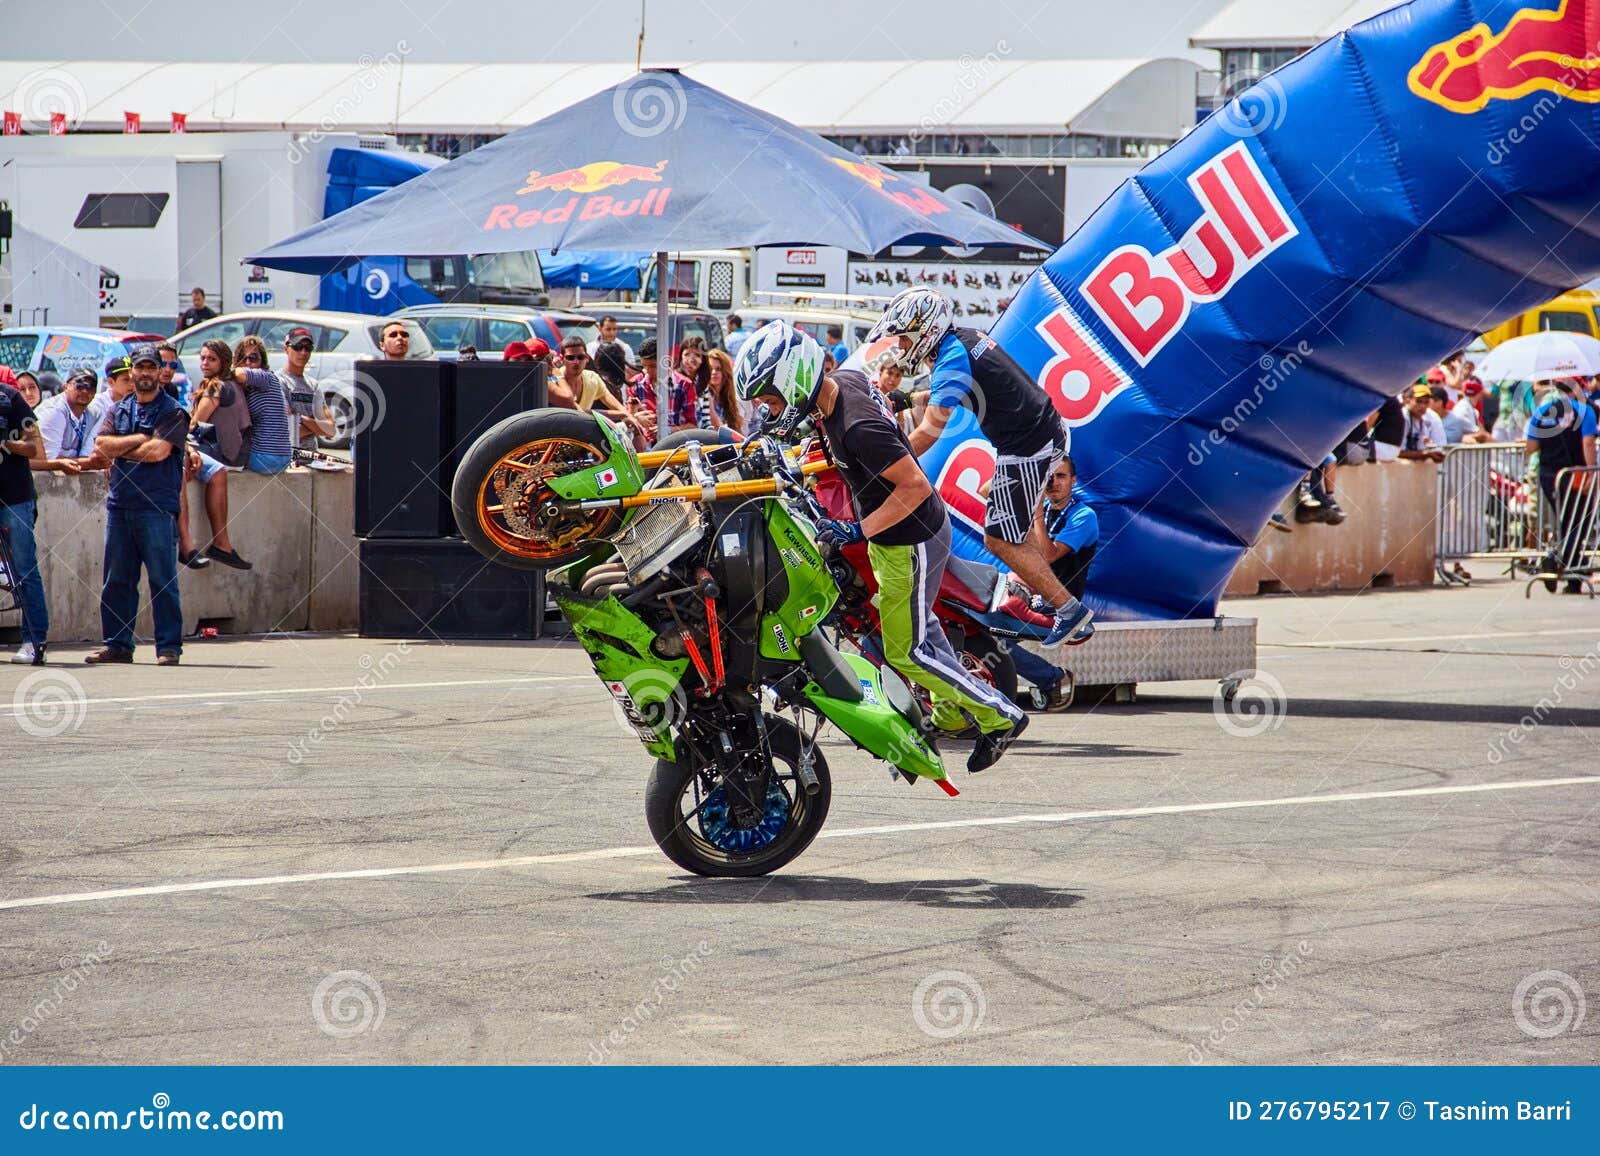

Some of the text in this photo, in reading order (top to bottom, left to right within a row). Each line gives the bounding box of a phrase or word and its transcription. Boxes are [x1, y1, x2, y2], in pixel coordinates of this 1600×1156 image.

[483, 187, 672, 231] Red Bull
[1081, 144, 1296, 363] Bull
[244, 292, 272, 304] OMP
[784, 527, 819, 570] Kawasaki
[775, 629, 790, 653] IPONE
